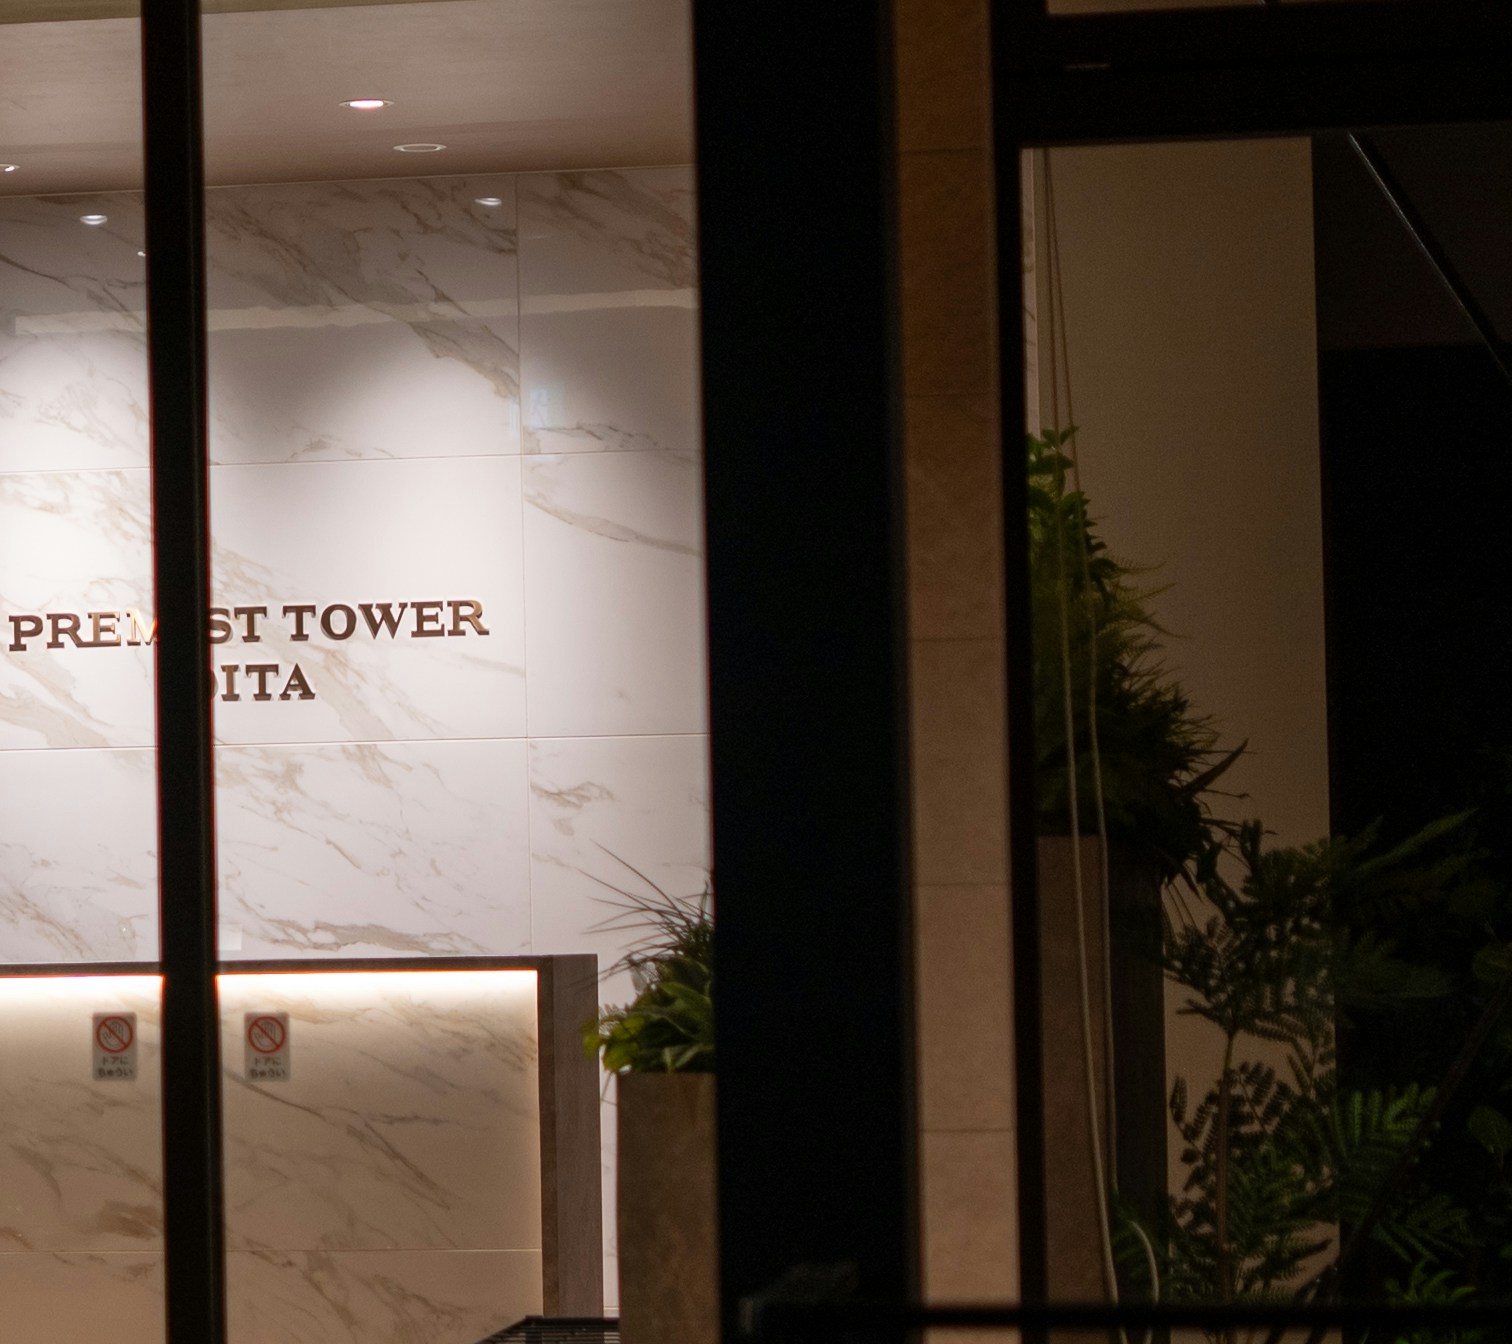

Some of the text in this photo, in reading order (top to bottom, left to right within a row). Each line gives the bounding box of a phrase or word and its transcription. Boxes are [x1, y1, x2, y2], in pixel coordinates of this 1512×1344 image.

[8, 599, 491, 652] PREMST TOWER
[210, 663, 317, 702] ITA
